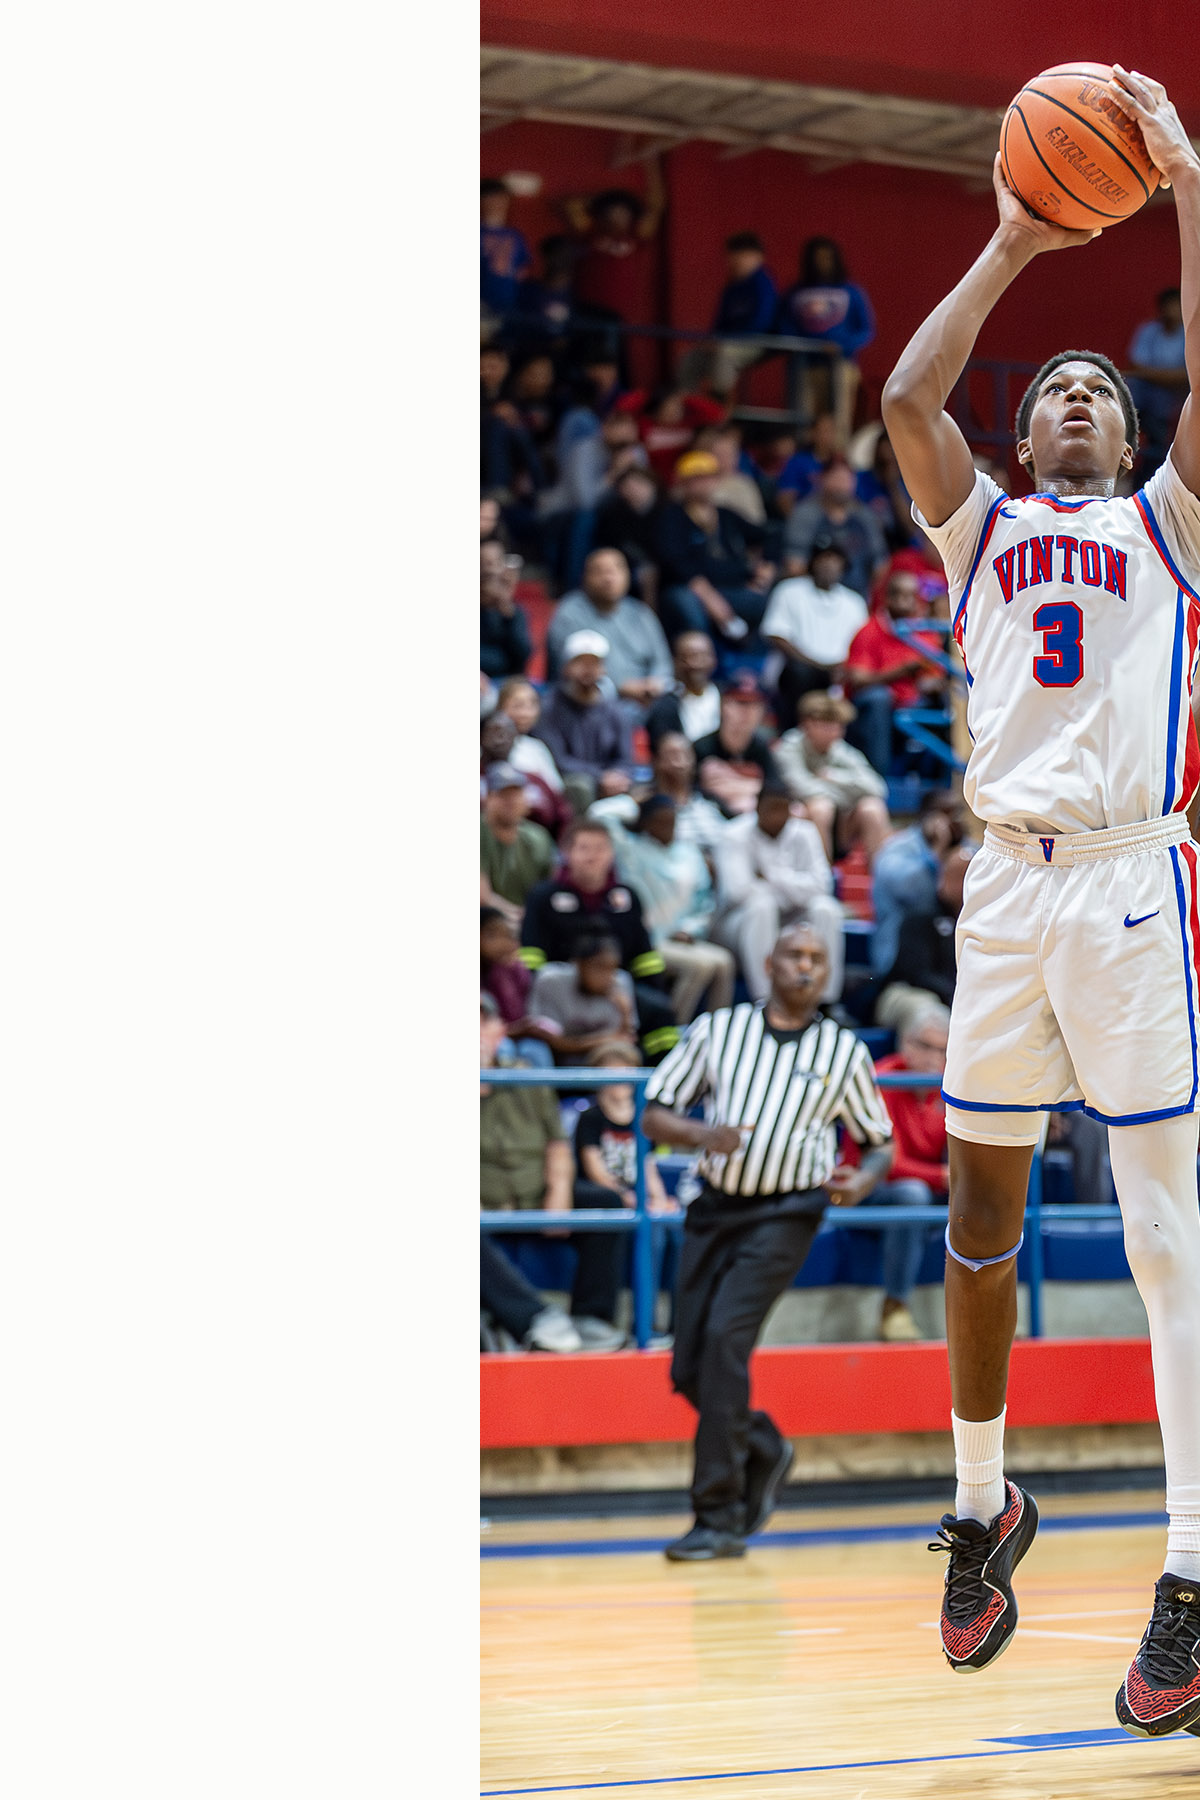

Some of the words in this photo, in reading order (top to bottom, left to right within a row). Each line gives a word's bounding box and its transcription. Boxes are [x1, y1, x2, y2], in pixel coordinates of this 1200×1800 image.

[1045, 126, 1130, 205] EVOLUTION
[993, 535, 1128, 605] VINTON
[1033, 601, 1084, 688] 3
[1039, 837, 1055, 863] V
